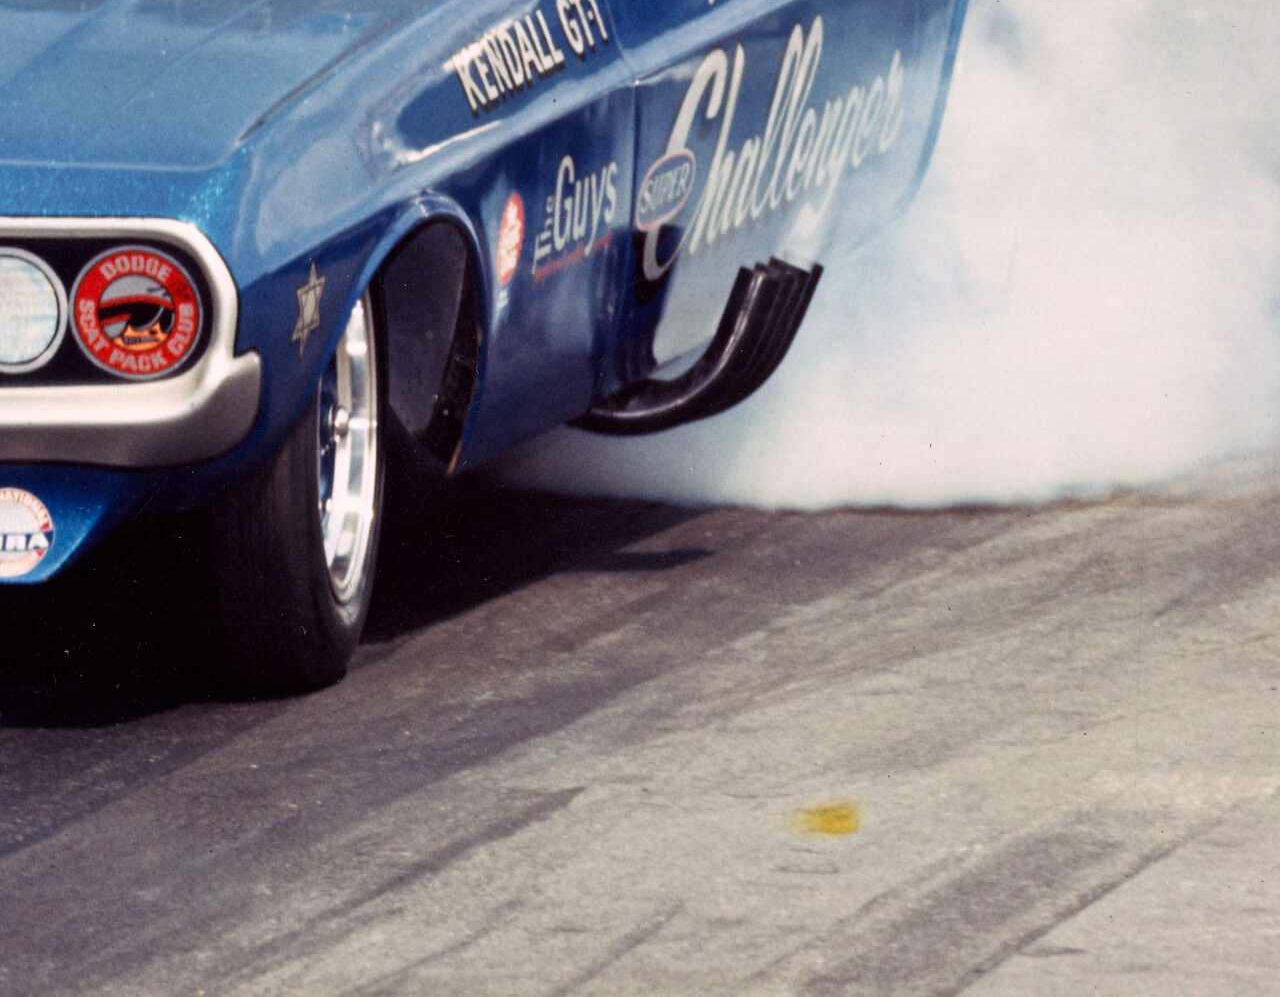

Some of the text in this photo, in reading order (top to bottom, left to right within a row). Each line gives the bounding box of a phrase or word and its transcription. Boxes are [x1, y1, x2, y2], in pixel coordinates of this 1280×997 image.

[451, 8, 566, 114] KENDALL
[641, 14, 904, 281] Challenger
[553, 153, 618, 257] Guys
[99, 255, 172, 283] DODGE
[78, 299, 195, 371] SCAT PACK CLUB
